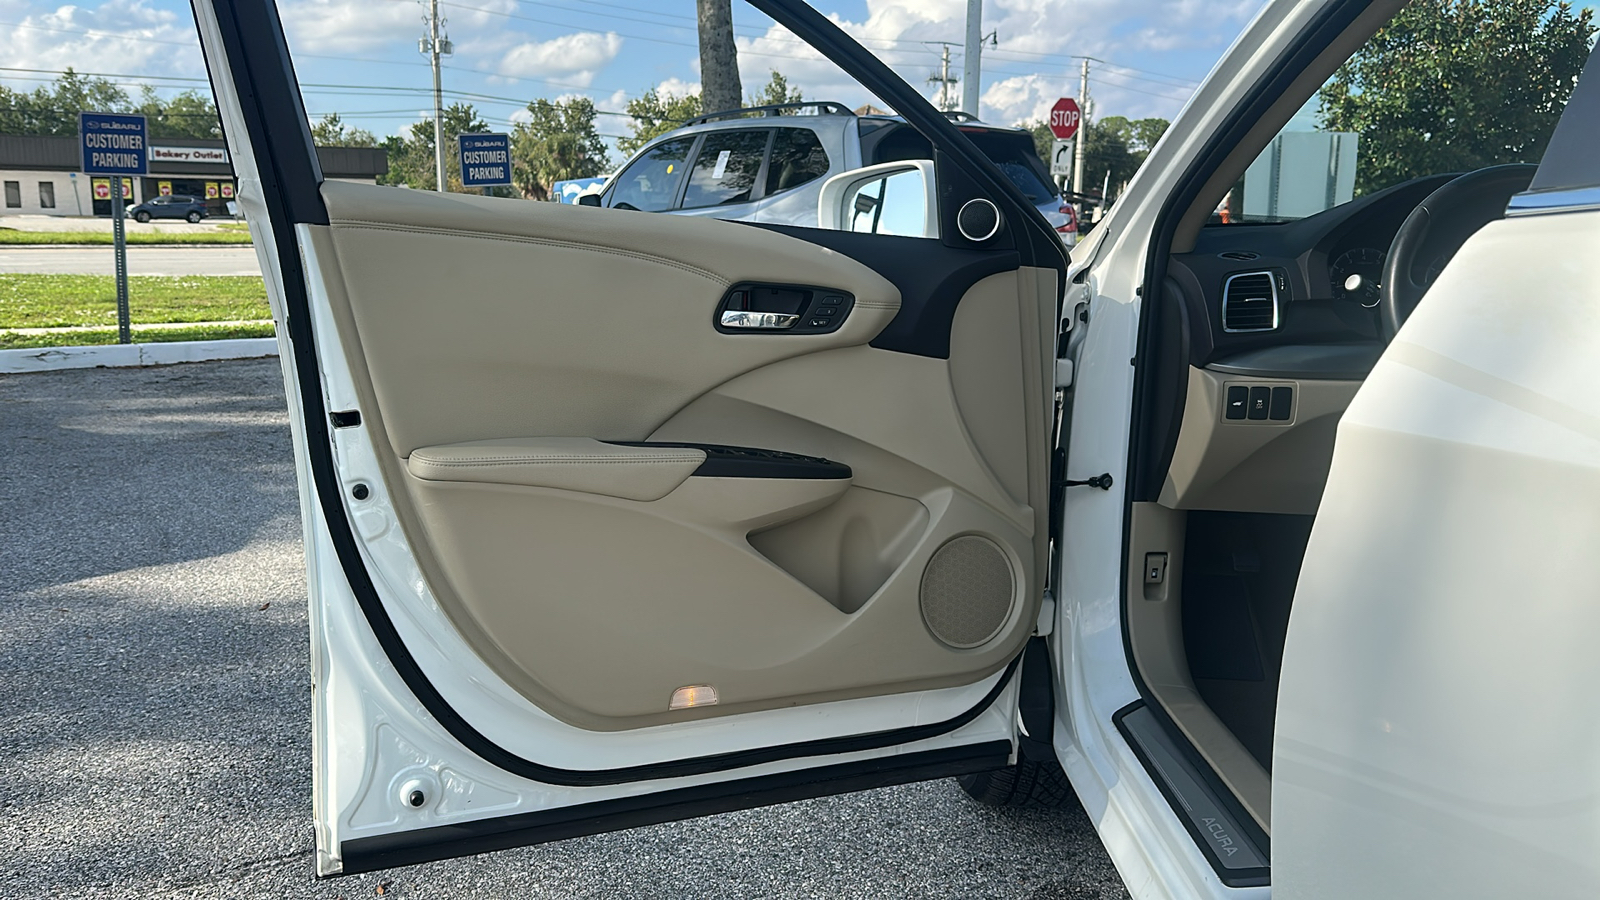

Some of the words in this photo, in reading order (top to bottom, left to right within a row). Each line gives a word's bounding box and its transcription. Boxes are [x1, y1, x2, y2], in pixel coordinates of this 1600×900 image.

[101, 121, 141, 130] SUBARU
[1051, 110, 1079, 127] STOP
[86, 133, 143, 149] CUSTOMER
[92, 152, 139, 168] PARKING
[155, 150, 190, 159] Bakery
[193, 151, 223, 159] Outlet
[463, 151, 507, 164] CUSTOMER
[469, 166, 505, 180] PARKING
[1053, 165, 1068, 173] ONLY
[1201, 817, 1238, 857] ACURA
